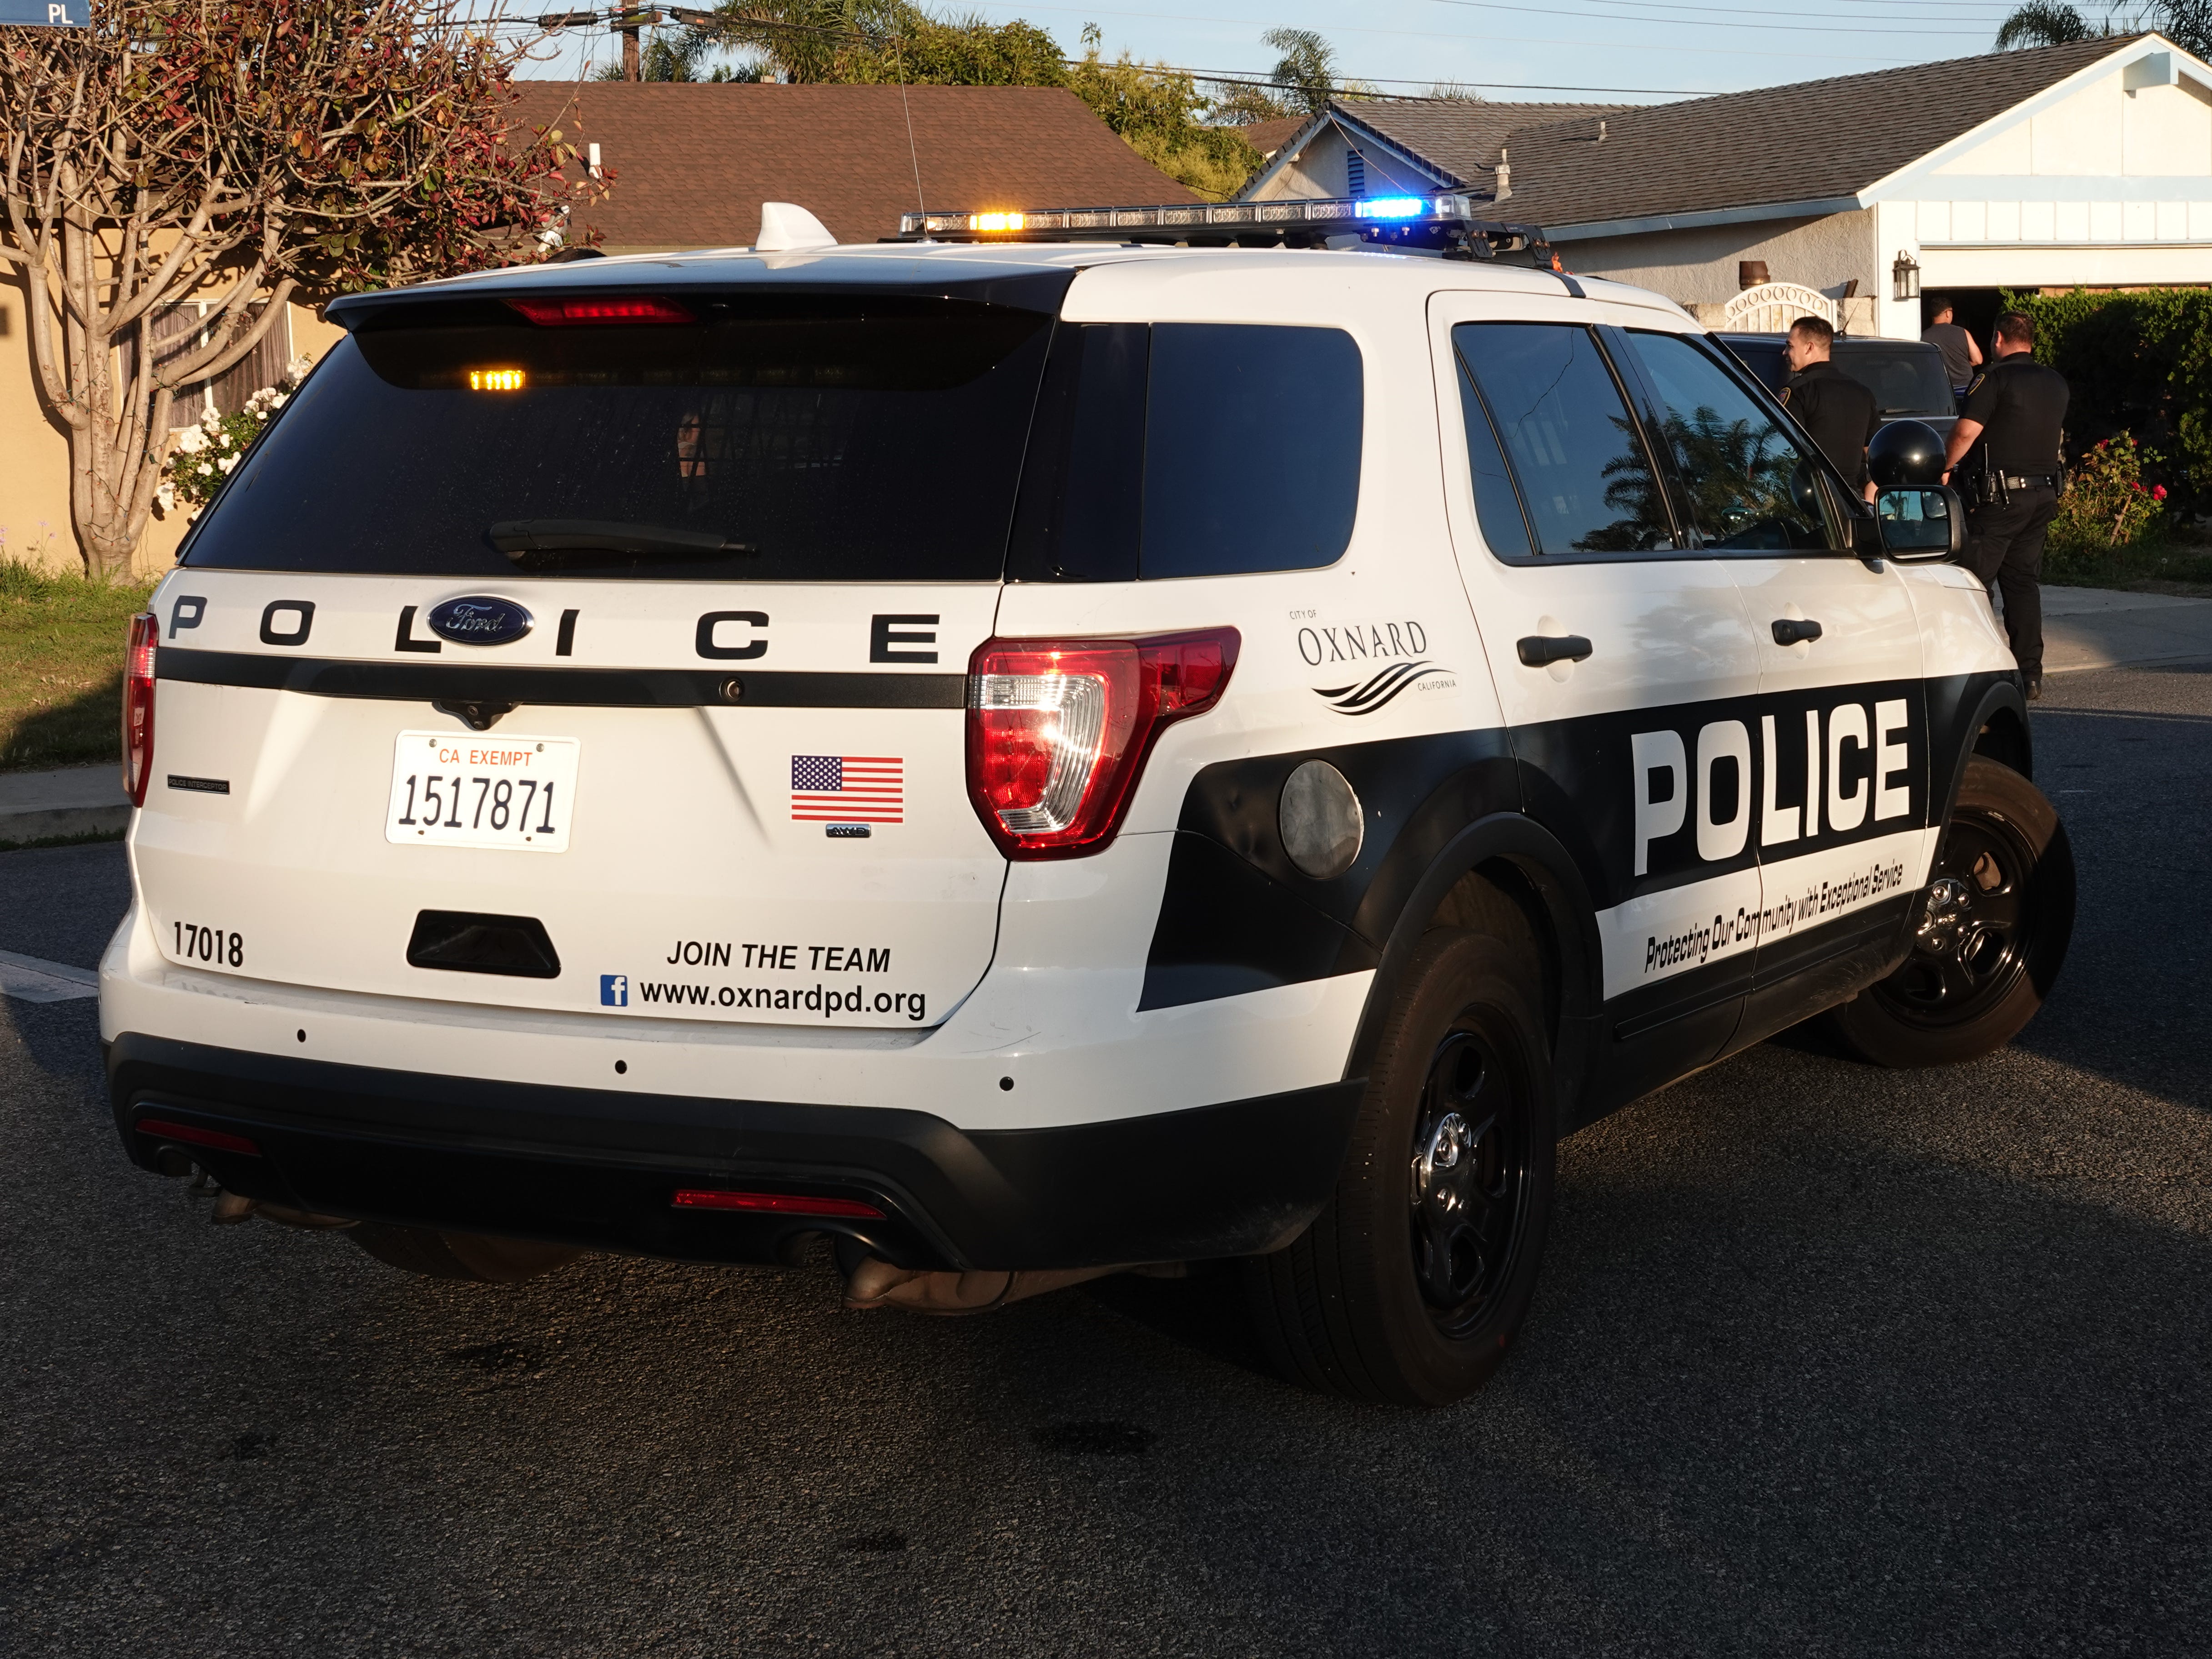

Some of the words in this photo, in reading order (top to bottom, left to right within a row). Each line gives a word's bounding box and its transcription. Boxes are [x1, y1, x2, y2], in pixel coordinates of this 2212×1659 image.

[48, 4, 74, 24] PL
[168, 595, 940, 664] POLICE
[445, 603, 506, 632] Ford
[1290, 610, 1306, 619] CITY
[1307, 609, 1317, 618] OF
[1298, 621, 1427, 666] OXNARD
[1418, 679, 1457, 691] CALIFORNIA
[439, 749, 460, 764] CA
[470, 750, 533, 767] EXEMPT
[169, 778, 186, 787] POLICE
[188, 781, 227, 790] INTERCEPTOR
[1631, 699, 1910, 877] POLICE
[398, 775, 556, 834] 1517871
[829, 827, 866, 835] AWD
[1644, 922, 1710, 974] Protecting
[1711, 915, 1734, 950] Our
[1735, 894, 1797, 942] Community
[1798, 885, 1819, 921] with
[1820, 866, 1872, 915] Exceptional
[1871, 858, 1904, 895] Service
[174, 921, 243, 967] 17018
[667, 940, 732, 967] JOIN
[742, 943, 798, 970] THE
[807, 946, 891, 973] TEAM
[639, 982, 926, 1021] www.oxnardpd.org
